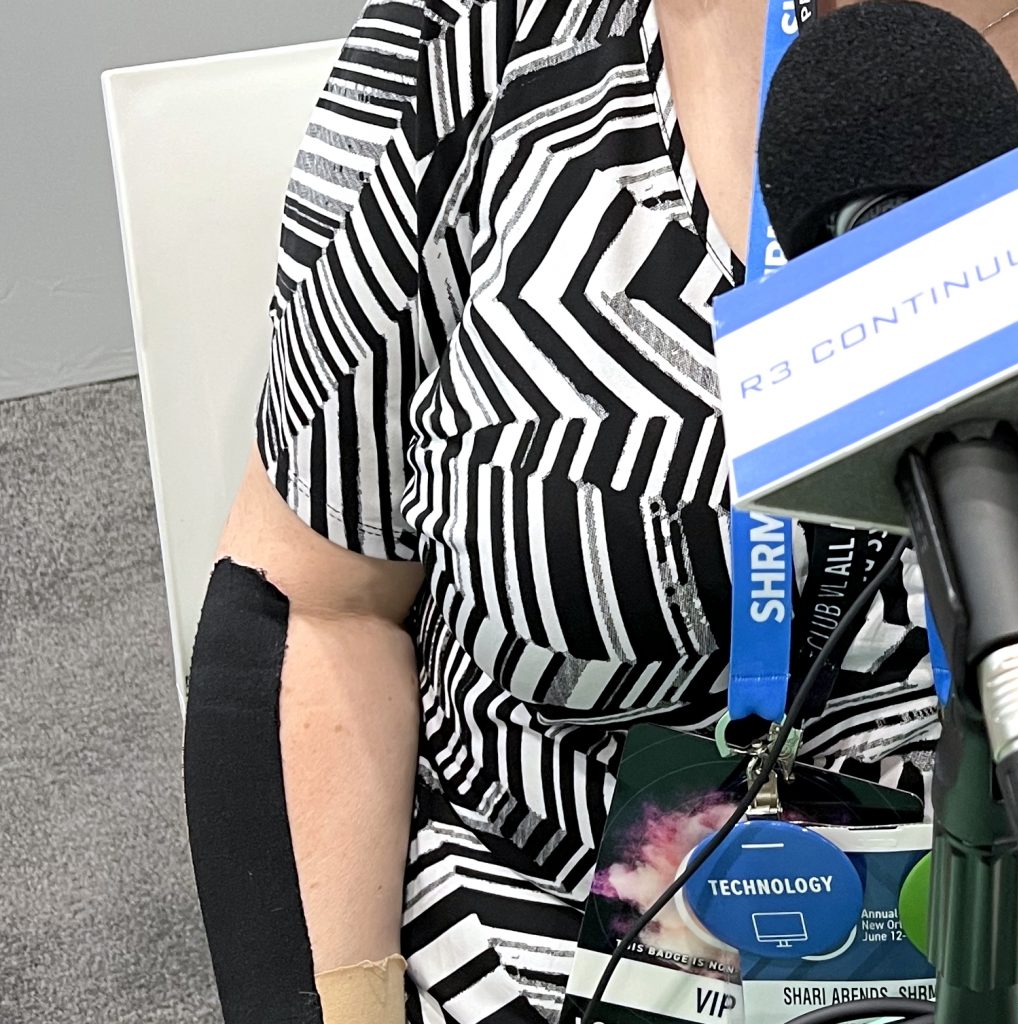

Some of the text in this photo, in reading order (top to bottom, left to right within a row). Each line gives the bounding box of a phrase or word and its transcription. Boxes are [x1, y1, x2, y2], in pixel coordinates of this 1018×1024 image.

[740, 360, 792, 399] R3
[750, 512, 785, 623] SHRM
[824, 537, 855, 576] ALL
[708, 875, 832, 896] TECHNOLOGY
[861, 908, 898, 919] Annual
[862, 920, 884, 930] New
[862, 932, 887, 941] June
[616, 939, 645, 953] TIS
[648, 946, 689, 964] BADGE
[692, 957, 704, 967] IS
[696, 987, 737, 1018] VIP
[783, 986, 826, 1005] SHARI
